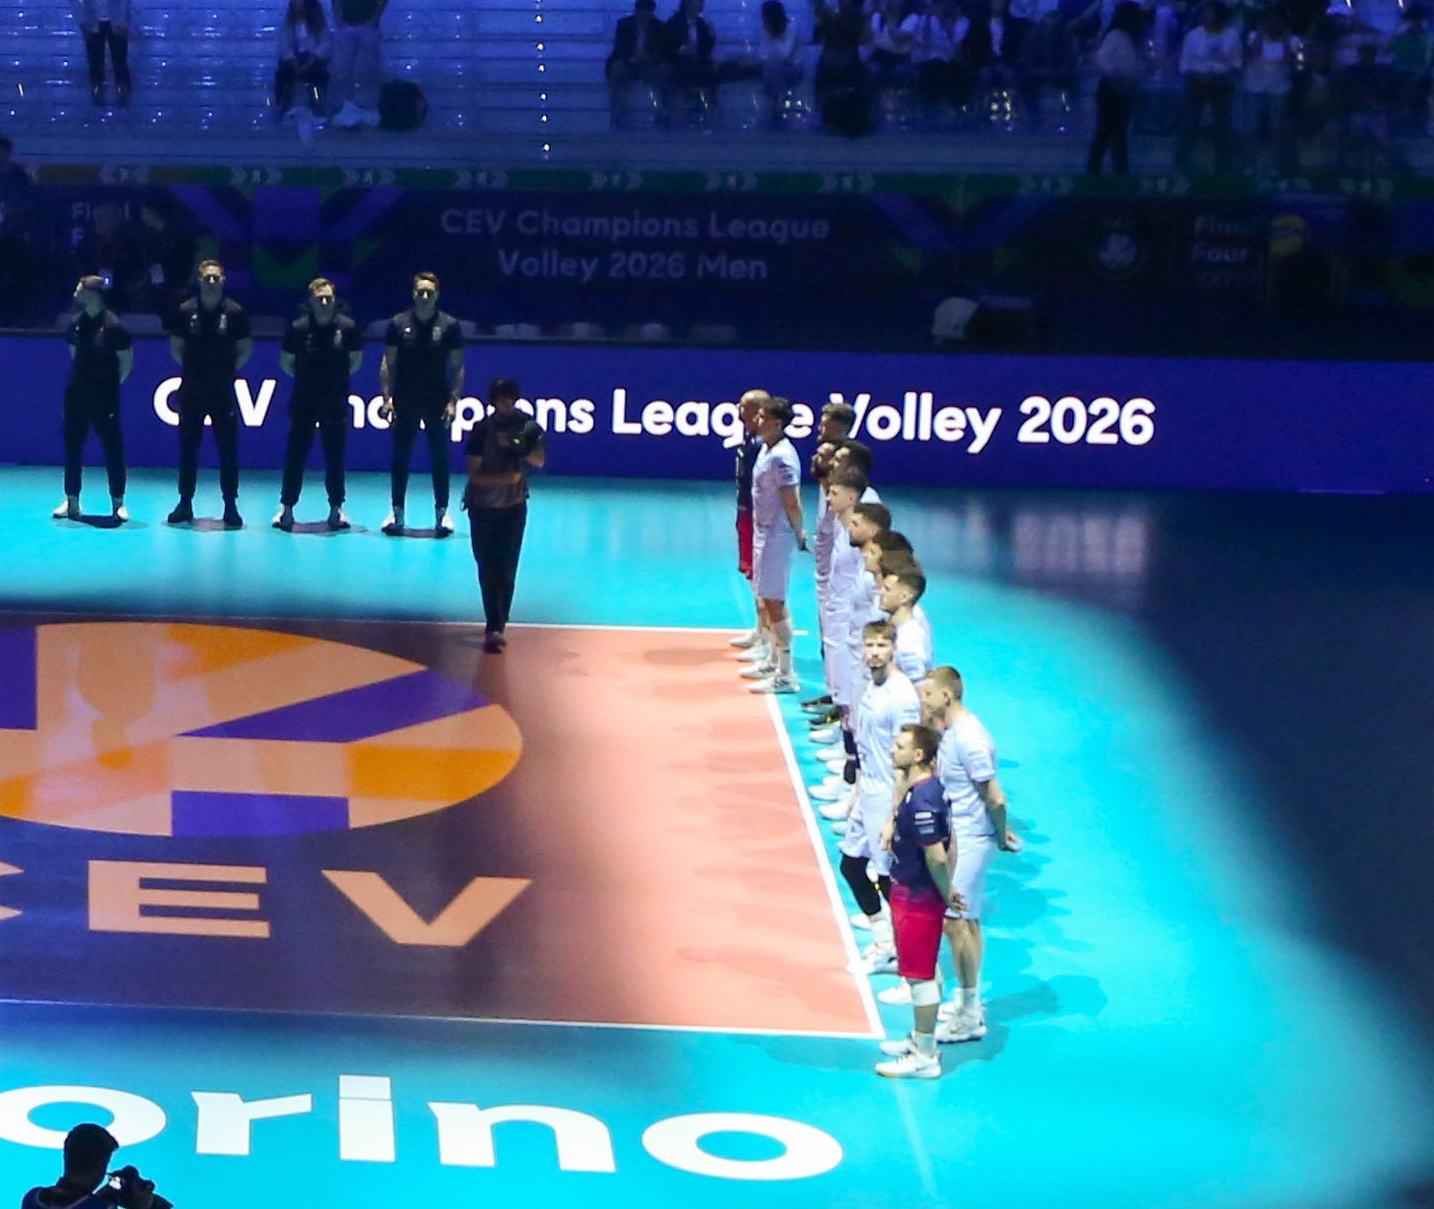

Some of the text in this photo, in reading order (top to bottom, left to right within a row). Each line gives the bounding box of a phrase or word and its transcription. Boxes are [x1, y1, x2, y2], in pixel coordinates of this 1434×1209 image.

[440, 208, 831, 245] CEV Champions League
[497, 249, 768, 283] Volley 2026 Men
[153, 376, 277, 426] CV
[612, 388, 815, 448] Leage
[1018, 395, 1156, 445] 2026
